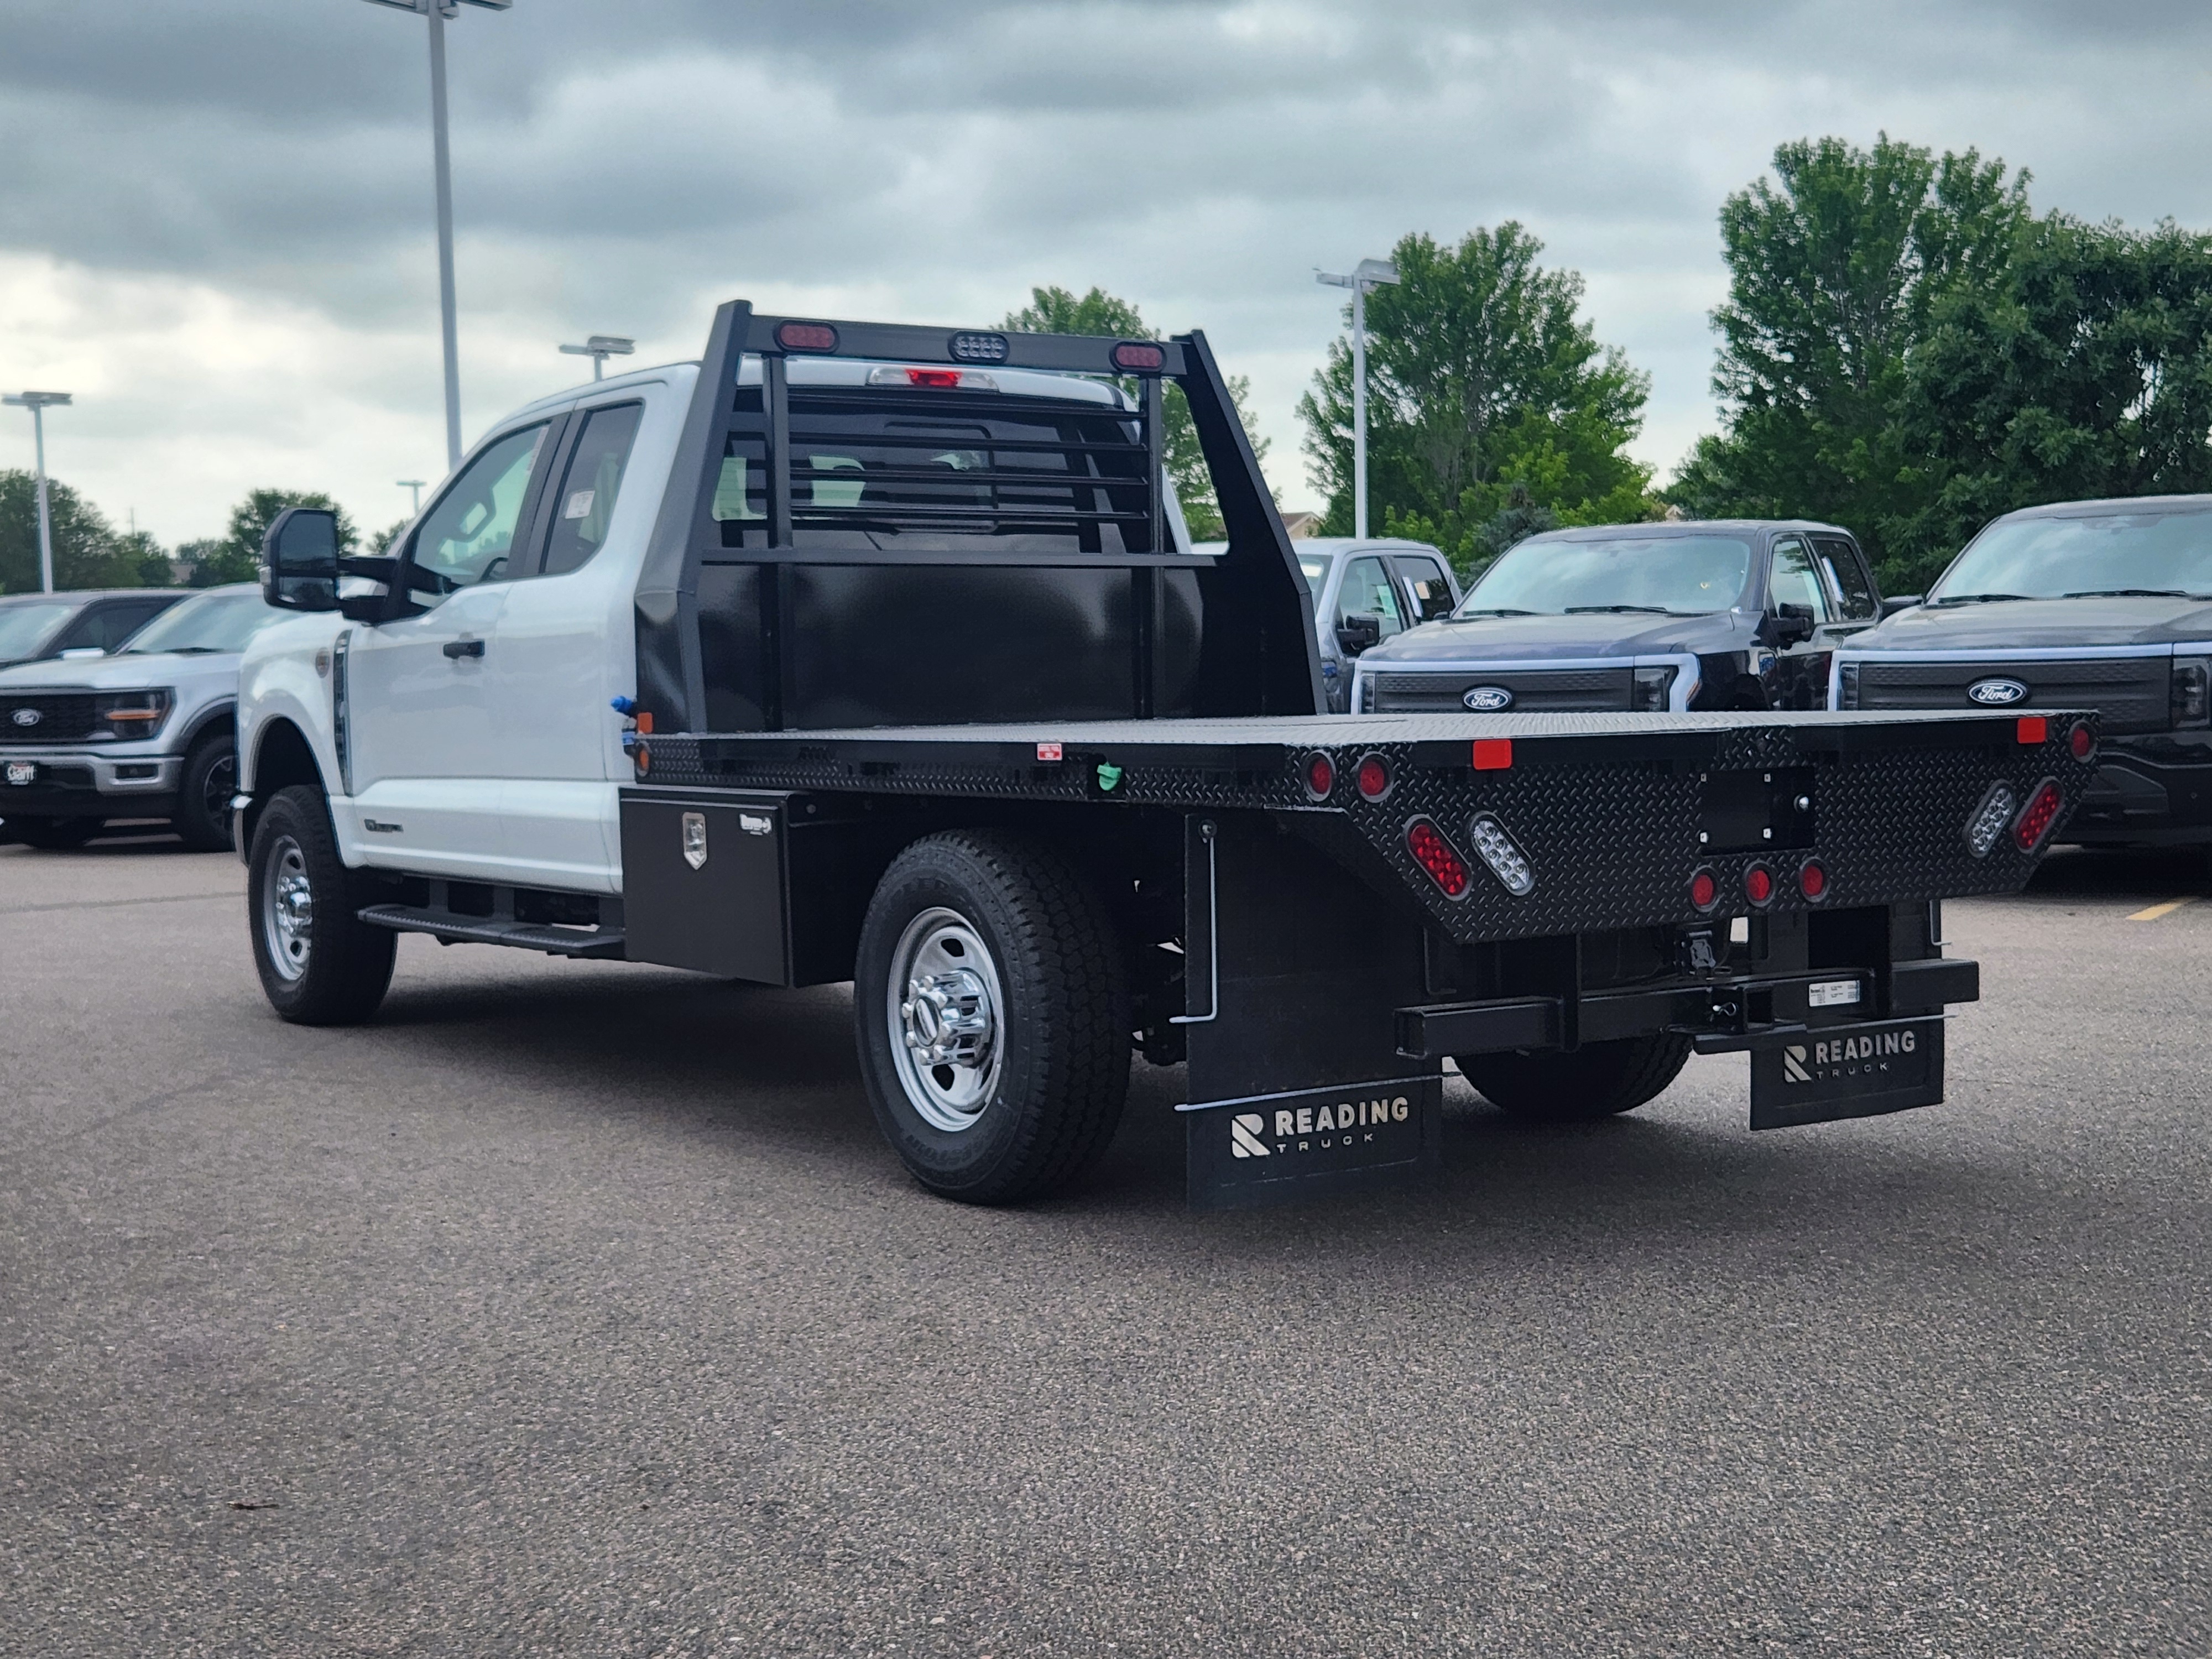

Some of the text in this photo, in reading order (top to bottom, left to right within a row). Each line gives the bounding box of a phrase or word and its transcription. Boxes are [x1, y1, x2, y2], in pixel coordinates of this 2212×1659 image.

[1471, 693, 1501, 706] Ford
[1978, 686, 2013, 701] Ford
[1815, 1030, 1916, 1065] READING
[1817, 1062, 1888, 1080] TRUCK
[1275, 1097, 1408, 1136] READING
[1276, 1133, 1373, 1154] TRUCK
